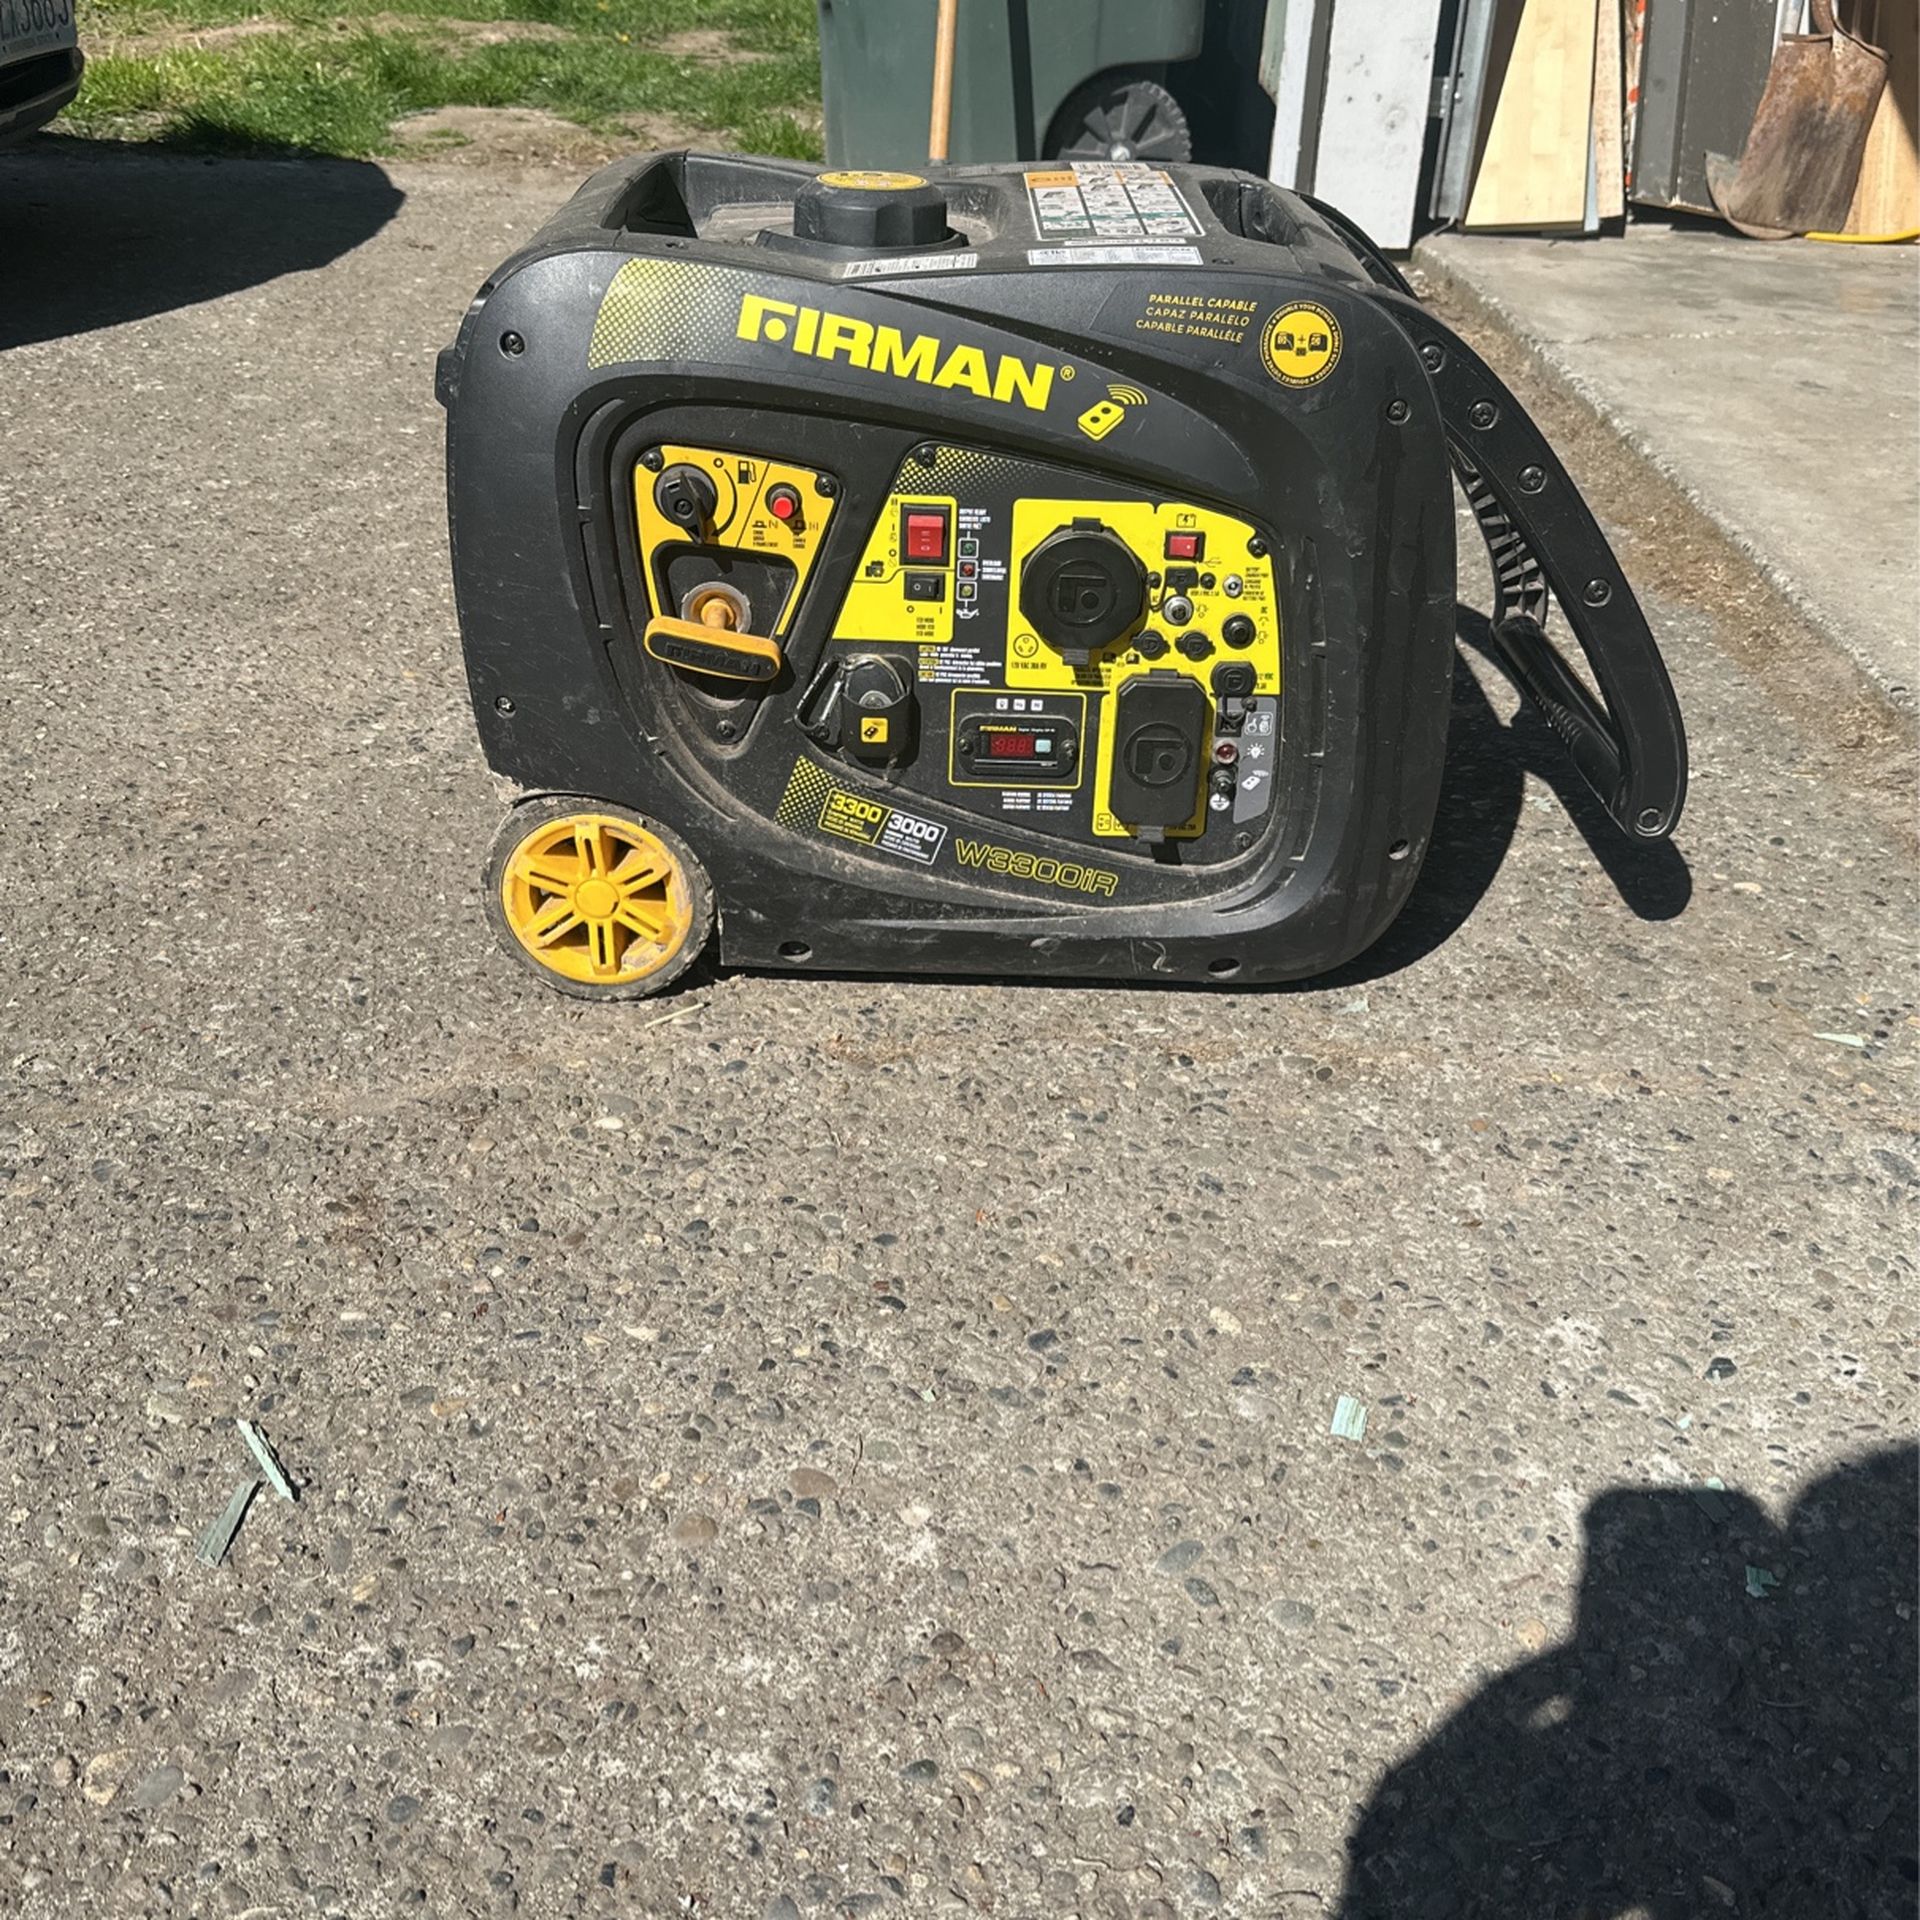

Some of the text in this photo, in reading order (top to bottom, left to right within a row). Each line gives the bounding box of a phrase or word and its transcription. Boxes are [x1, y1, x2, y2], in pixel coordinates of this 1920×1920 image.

[1149, 294, 1257, 312] PARALLEL CAPABLE
[1135, 319, 1184, 335] CAPABLE
[1145, 306, 1250, 327] CAPAZ PARALELO
[830, 794, 882, 823] 3300
[887, 813, 940, 842] 3000
[955, 838, 1119, 897] W3300iR
